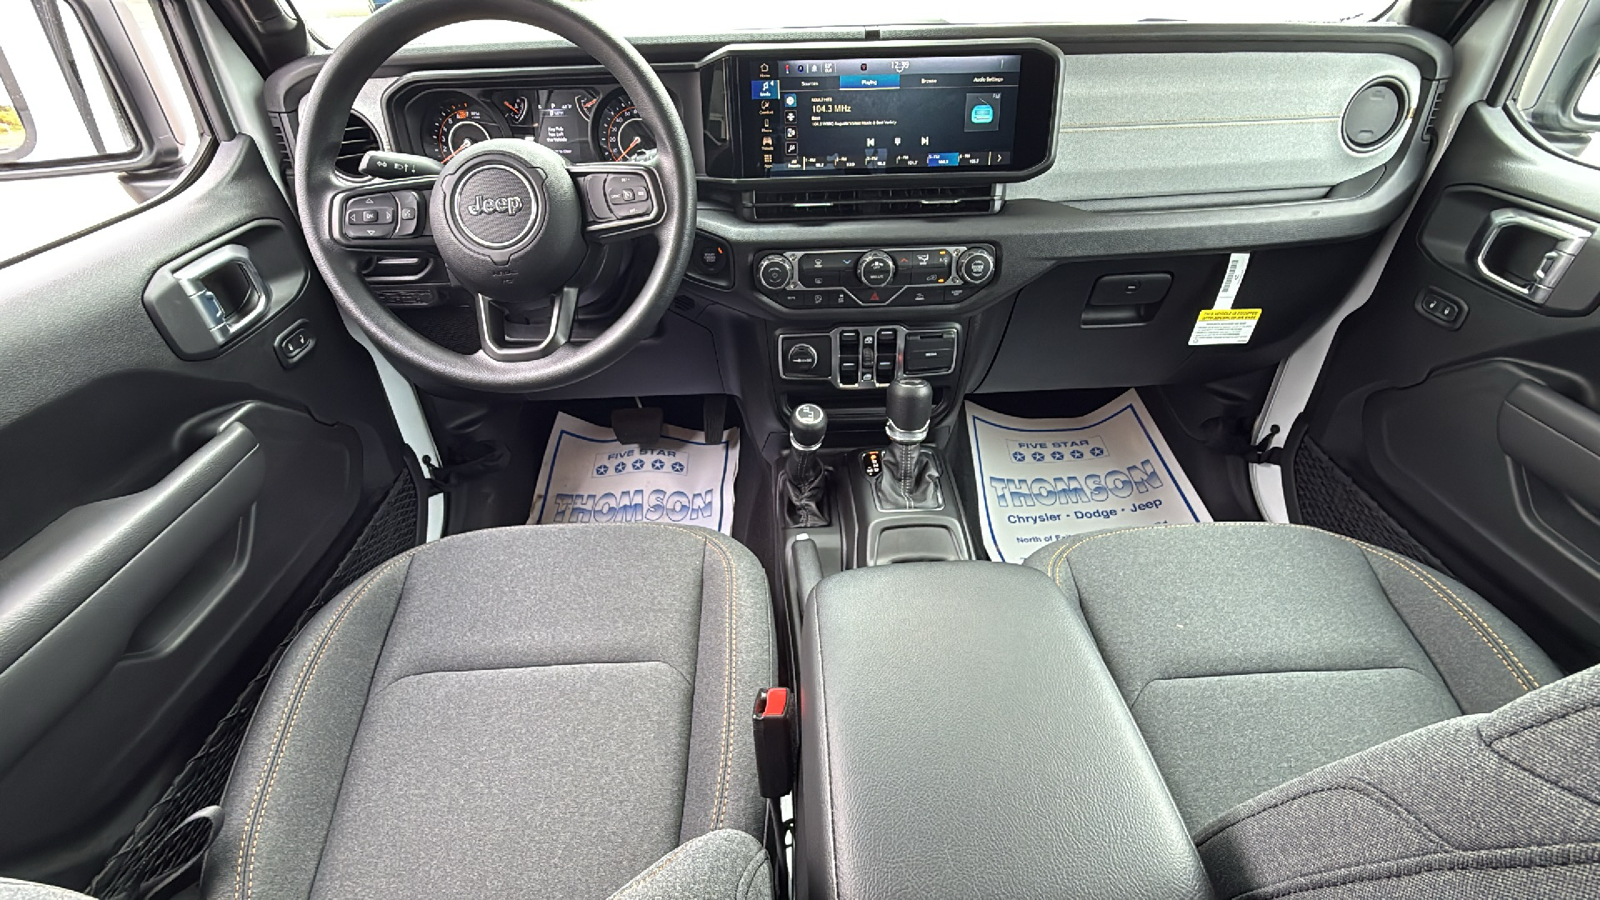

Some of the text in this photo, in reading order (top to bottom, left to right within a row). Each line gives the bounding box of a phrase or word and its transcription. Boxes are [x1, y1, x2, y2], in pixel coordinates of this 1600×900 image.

[812, 104, 852, 113] 104.3 MHz
[467, 195, 524, 216] Jeep
[1052, 439, 1090, 448] STAR
[608, 449, 676, 460] FIVE STAR
[990, 460, 1163, 507] THOMSON
[554, 488, 713, 523] THOMSON
[1007, 499, 1163, 524] Chrysler Dodge Jeep
